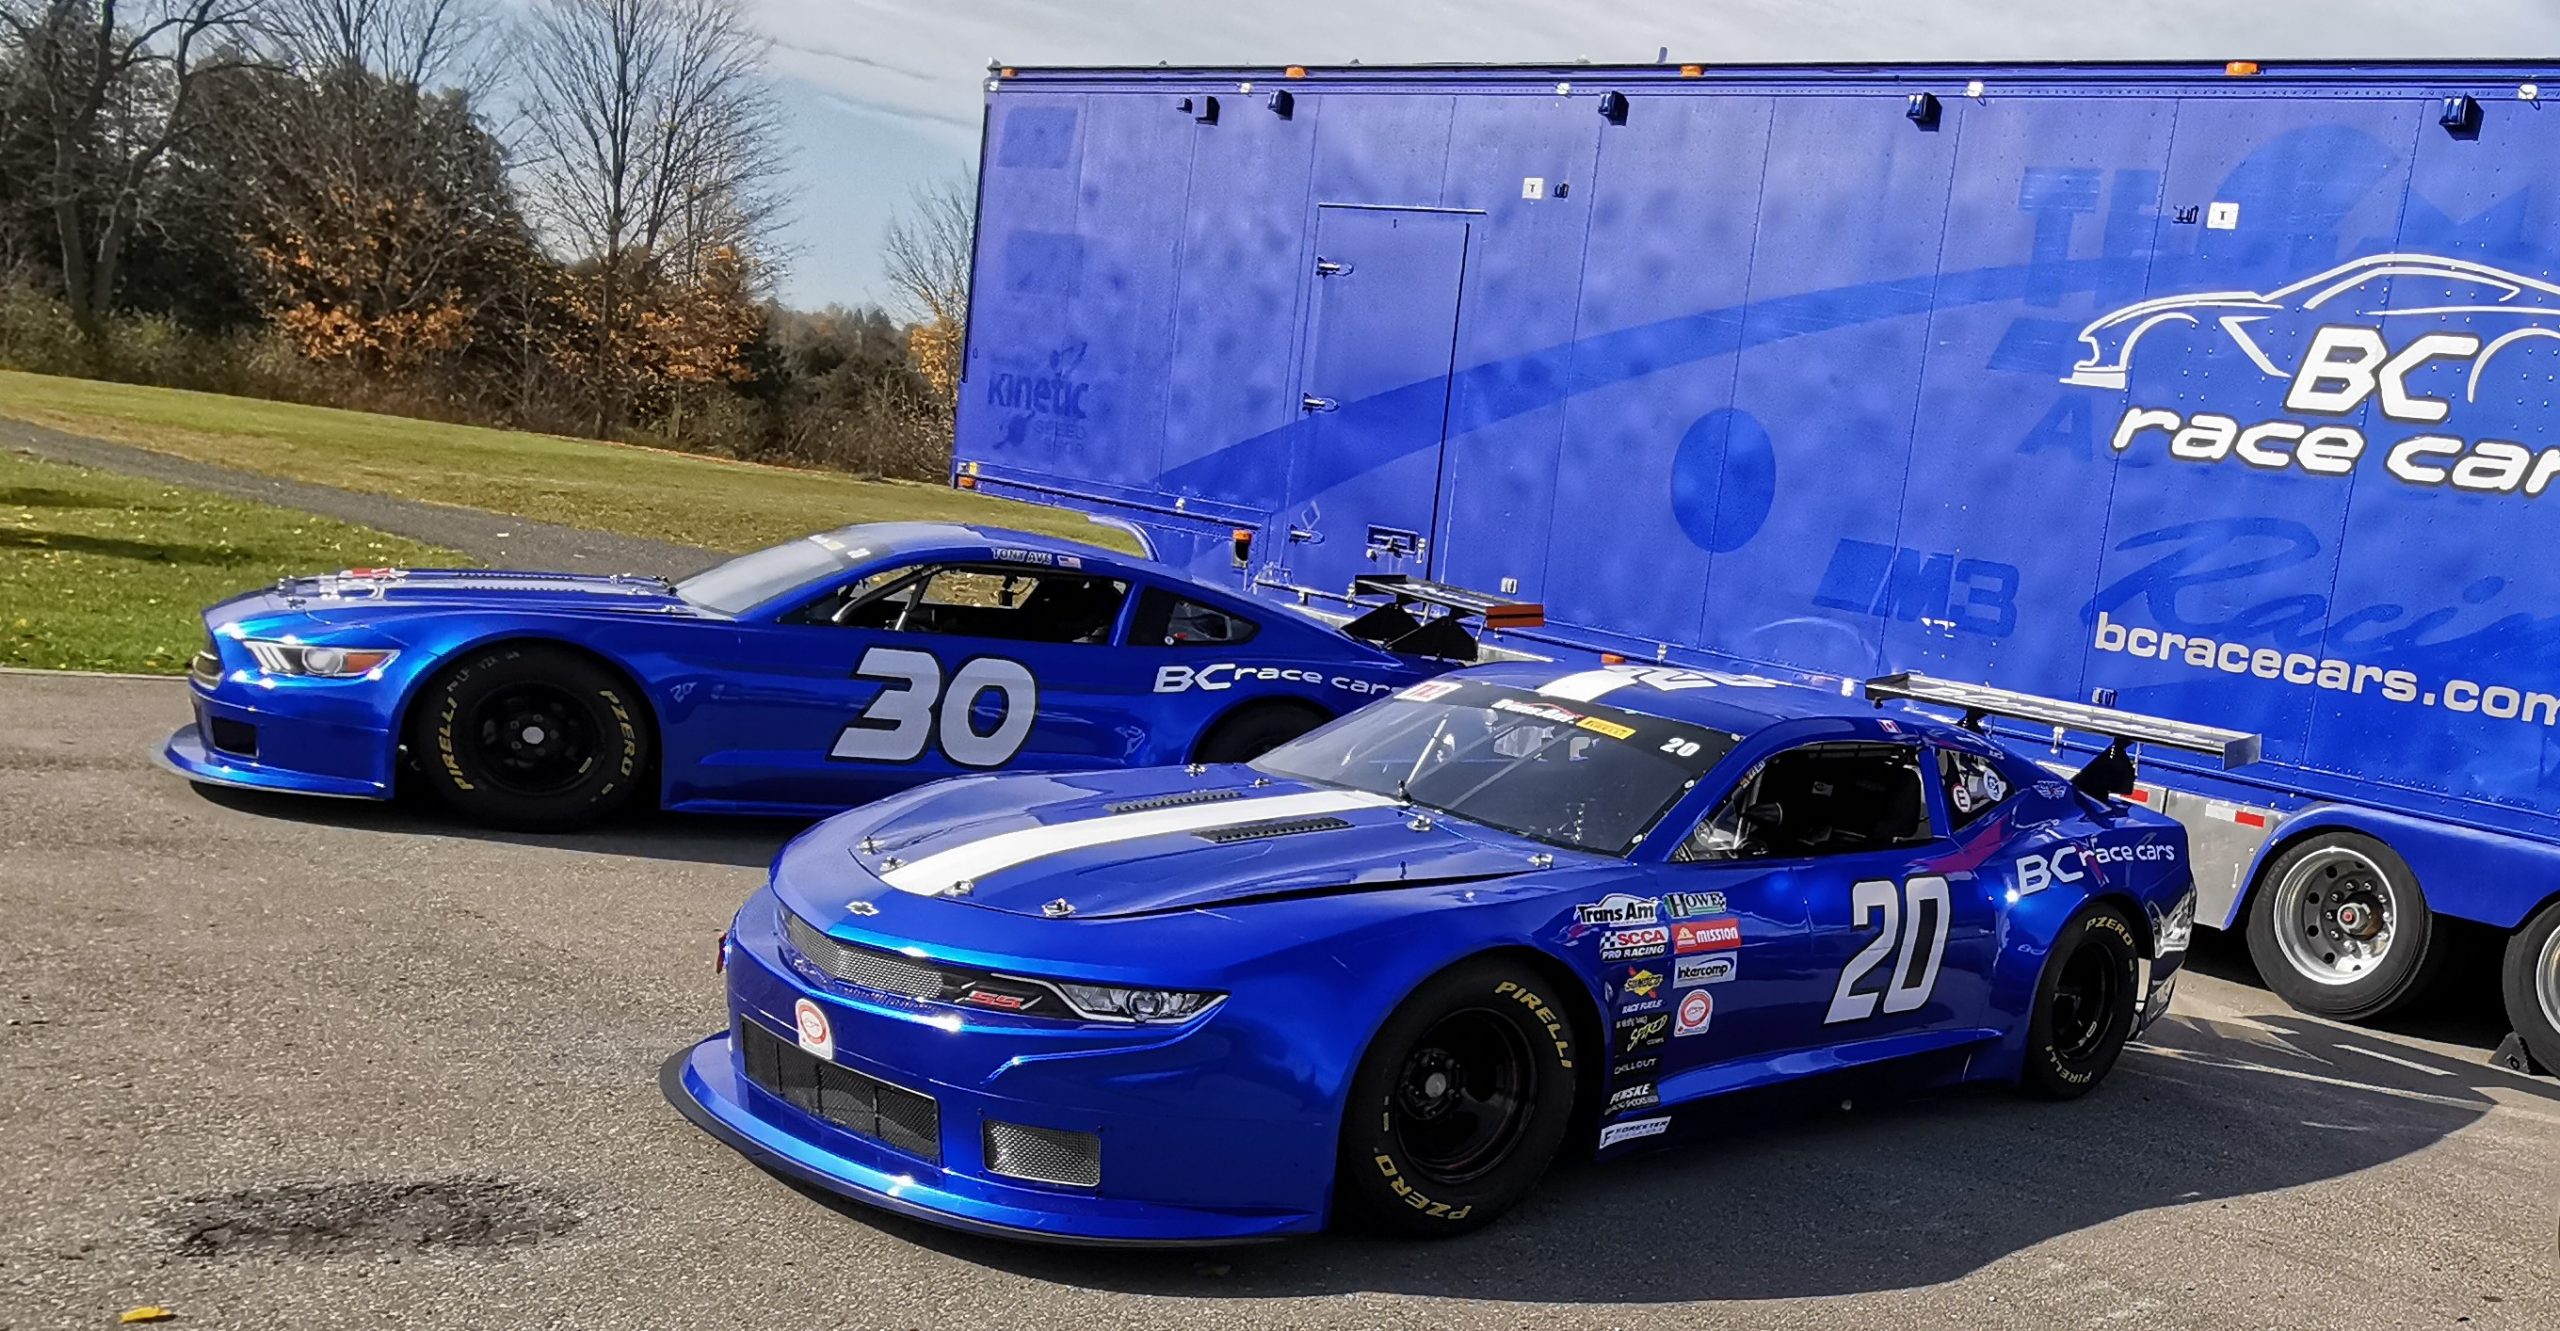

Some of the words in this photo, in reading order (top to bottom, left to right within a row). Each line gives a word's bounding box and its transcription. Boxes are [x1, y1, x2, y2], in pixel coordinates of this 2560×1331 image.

[2284, 326, 2480, 420] BC
[2112, 408, 2365, 473] race
[1153, 663, 1235, 692] BC
[1235, 667, 1322, 684] race
[829, 646, 1038, 767] 30
[438, 697, 475, 790] PIRELLI
[1659, 737, 1700, 757] 20
[2016, 846, 2084, 896] BC
[2079, 844, 2133, 867] race
[2136, 843, 2175, 861] cars
[1578, 905, 1622, 923] Trans
[1625, 902, 1655, 921] Am
[1669, 893, 1721, 917] HOWE
[1617, 929, 1665, 946] SCCA
[2085, 916, 2134, 947] PZERO
[1602, 949, 1622, 960] PRO
[1624, 945, 1665, 958] RACING
[1823, 876, 1951, 1024] 20
[1678, 964, 1729, 979] Intercomp
[969, 990, 1024, 1008] SS
[1494, 981, 1573, 1068] PIRELLI
[1375, 1154, 1472, 1219] PZERO
